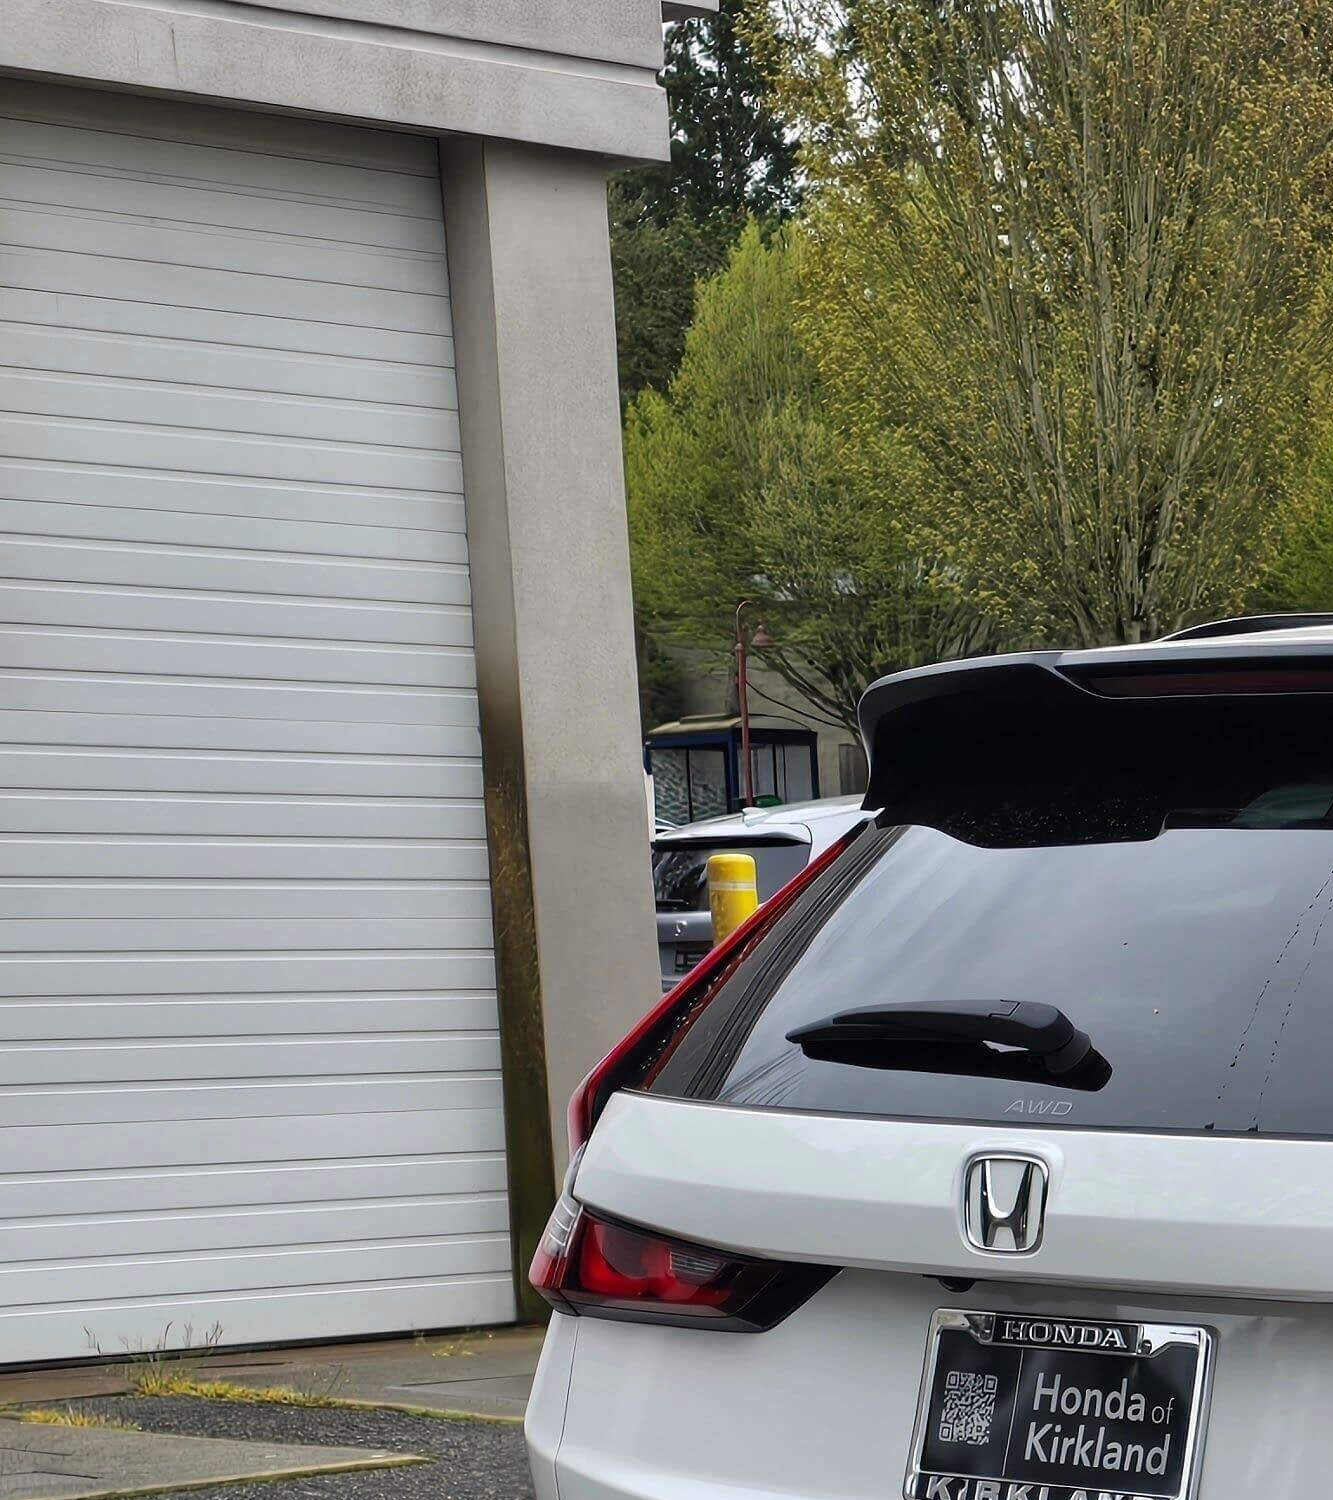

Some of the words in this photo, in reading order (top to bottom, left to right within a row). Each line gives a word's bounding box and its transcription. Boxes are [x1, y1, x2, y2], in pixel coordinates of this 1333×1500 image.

[1004, 1099, 1073, 1116] AWD
[1001, 1320, 1128, 1349] HONDA
[1032, 1372, 1146, 1422] Honda
[1151, 1397, 1175, 1425] of
[1023, 1421, 1171, 1476] Kirkland
